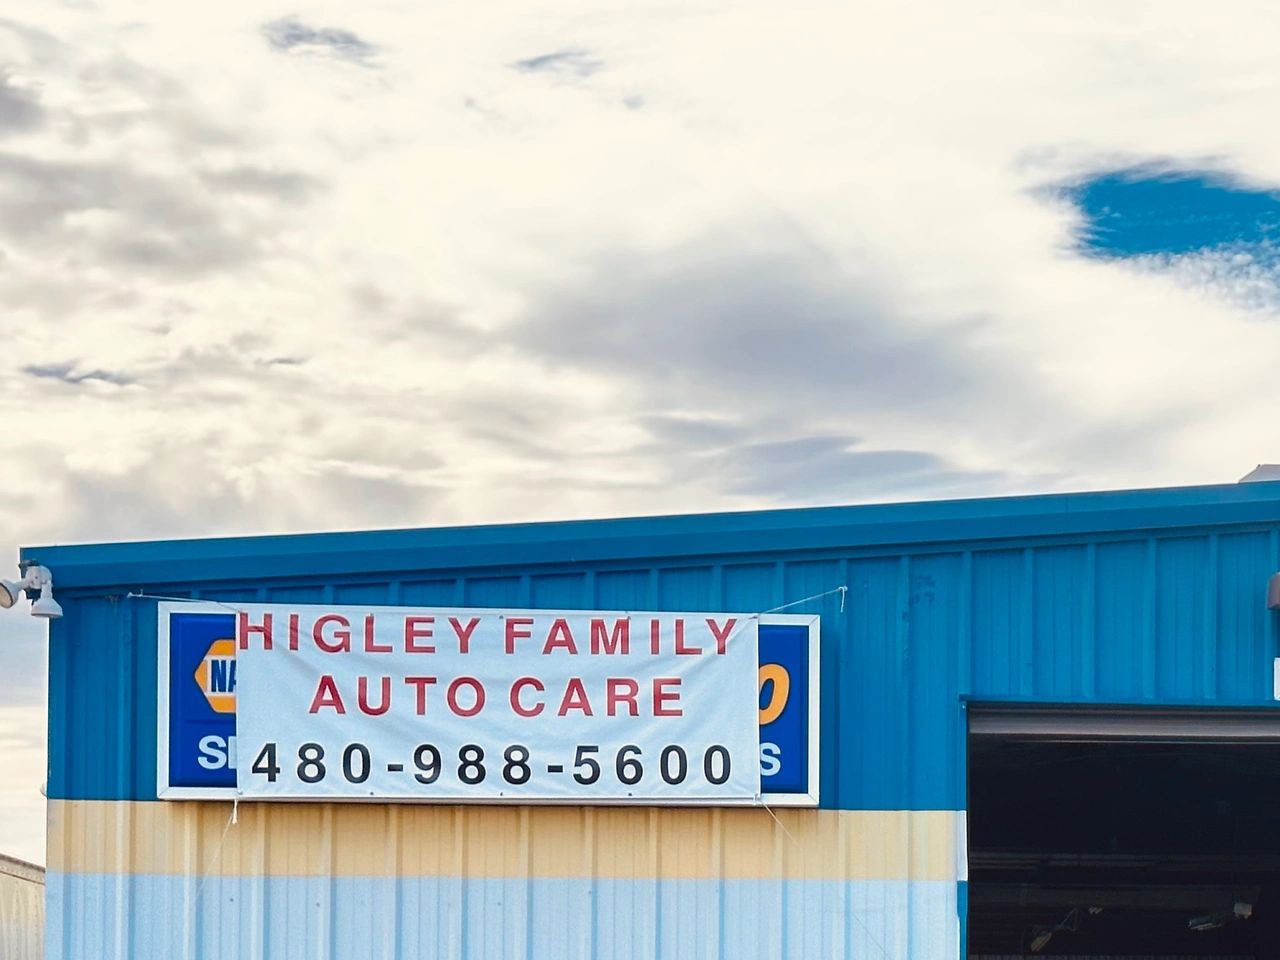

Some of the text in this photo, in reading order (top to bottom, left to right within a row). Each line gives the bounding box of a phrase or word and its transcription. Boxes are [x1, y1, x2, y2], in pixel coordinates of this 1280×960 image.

[239, 612, 737, 655] HIGLEY FAMILY
[308, 675, 683, 717] AUTO CARE
[252, 743, 731, 785] 480-988-5600
